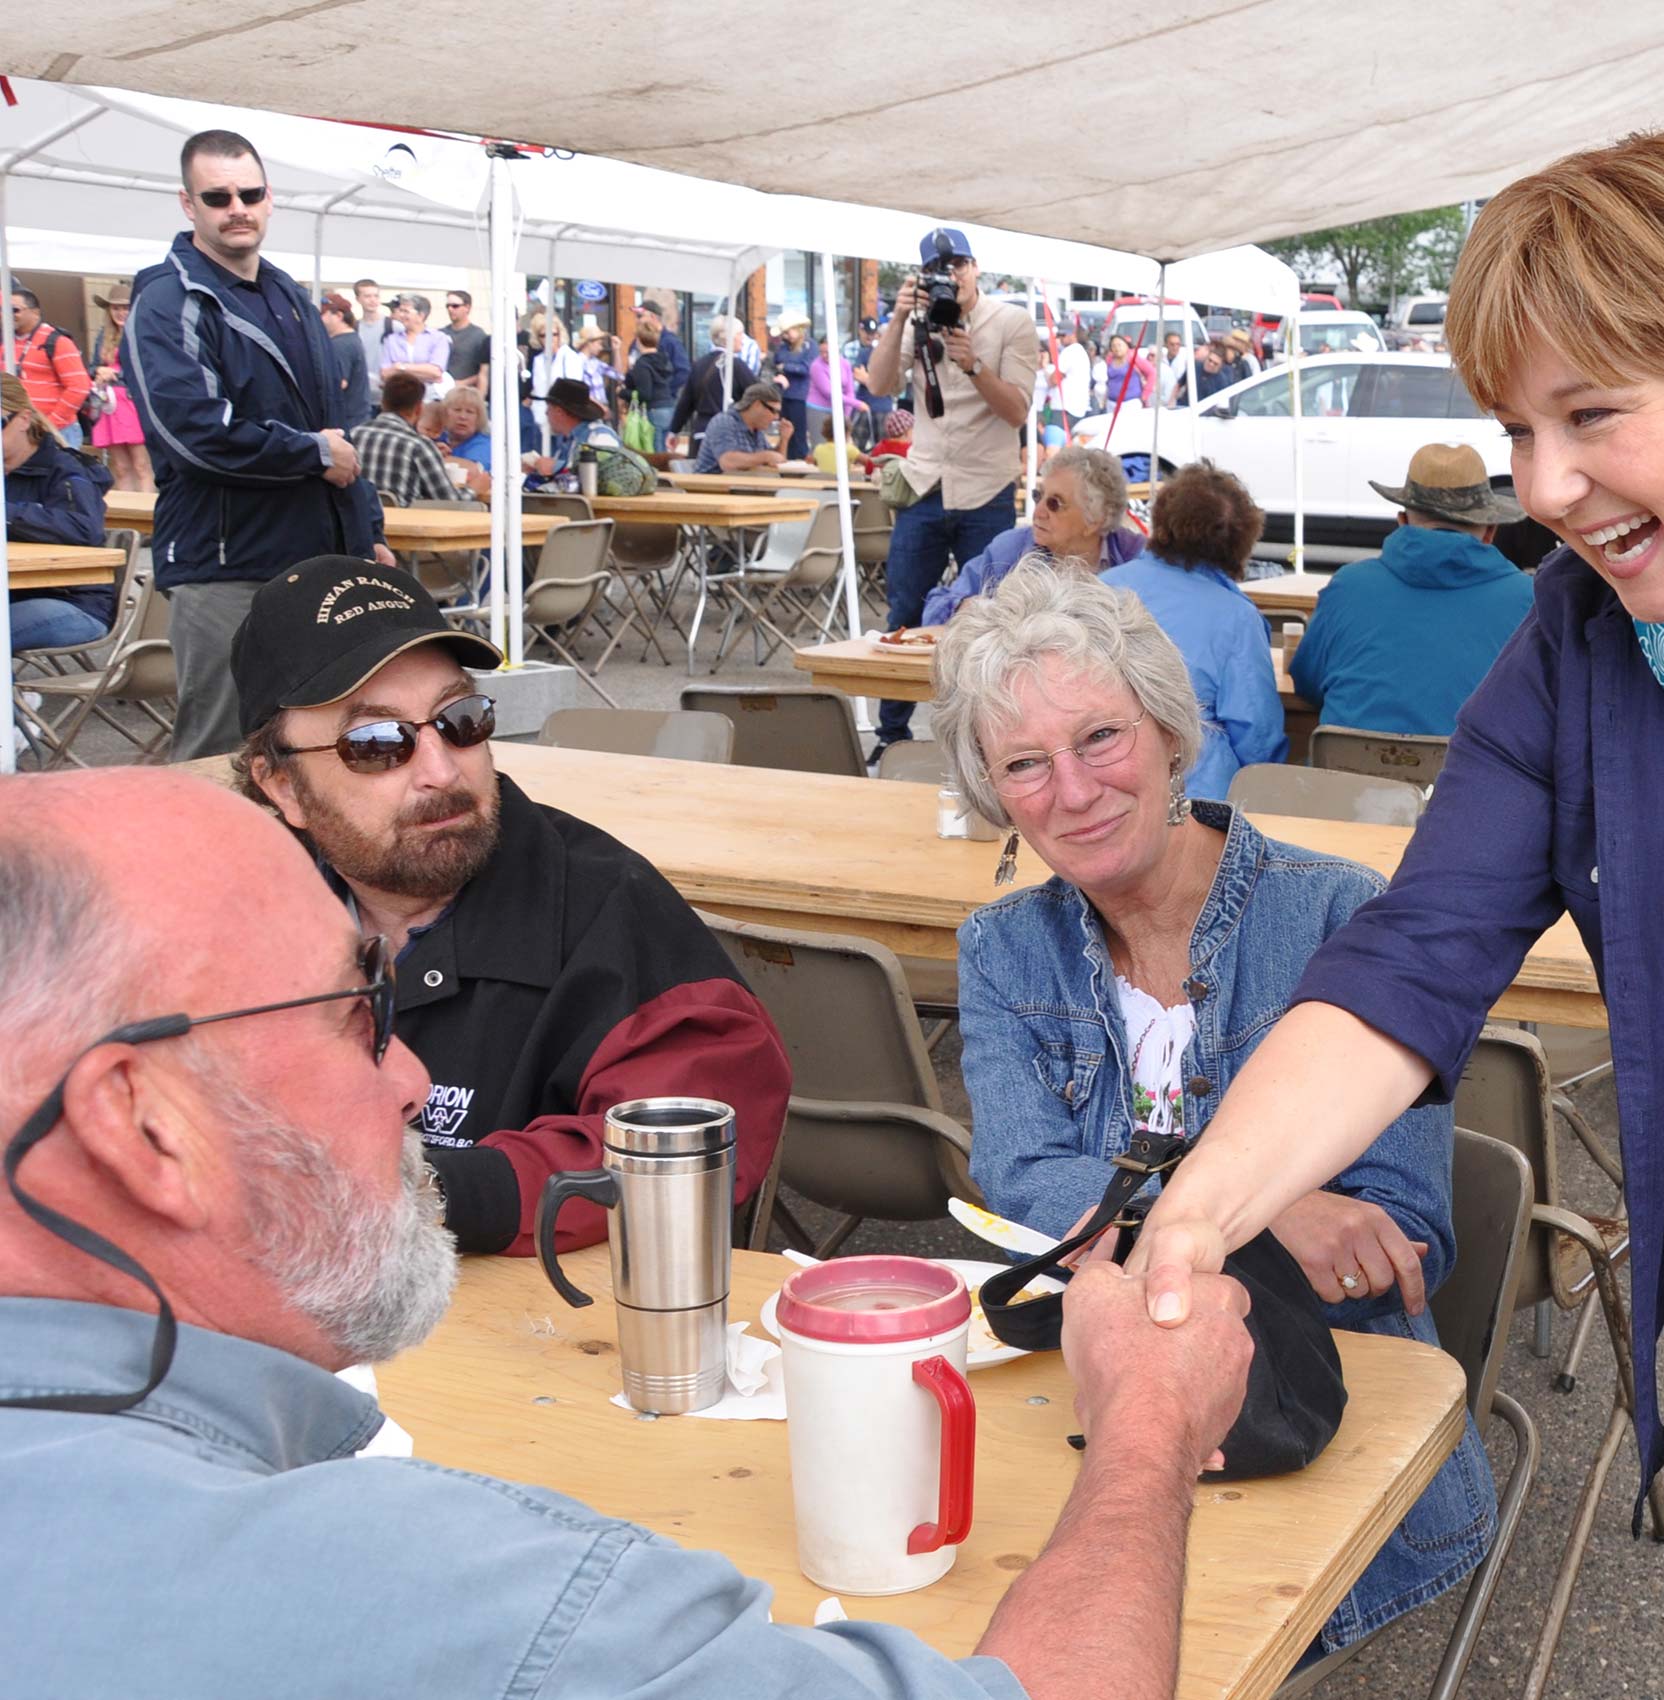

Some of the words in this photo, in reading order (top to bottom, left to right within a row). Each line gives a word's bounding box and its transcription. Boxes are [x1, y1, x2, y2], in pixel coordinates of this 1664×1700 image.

[316, 579, 355, 624] HIWAN
[355, 576, 416, 605] RANCH
[333, 605, 365, 625] RED
[368, 600, 411, 612] ANGUS
